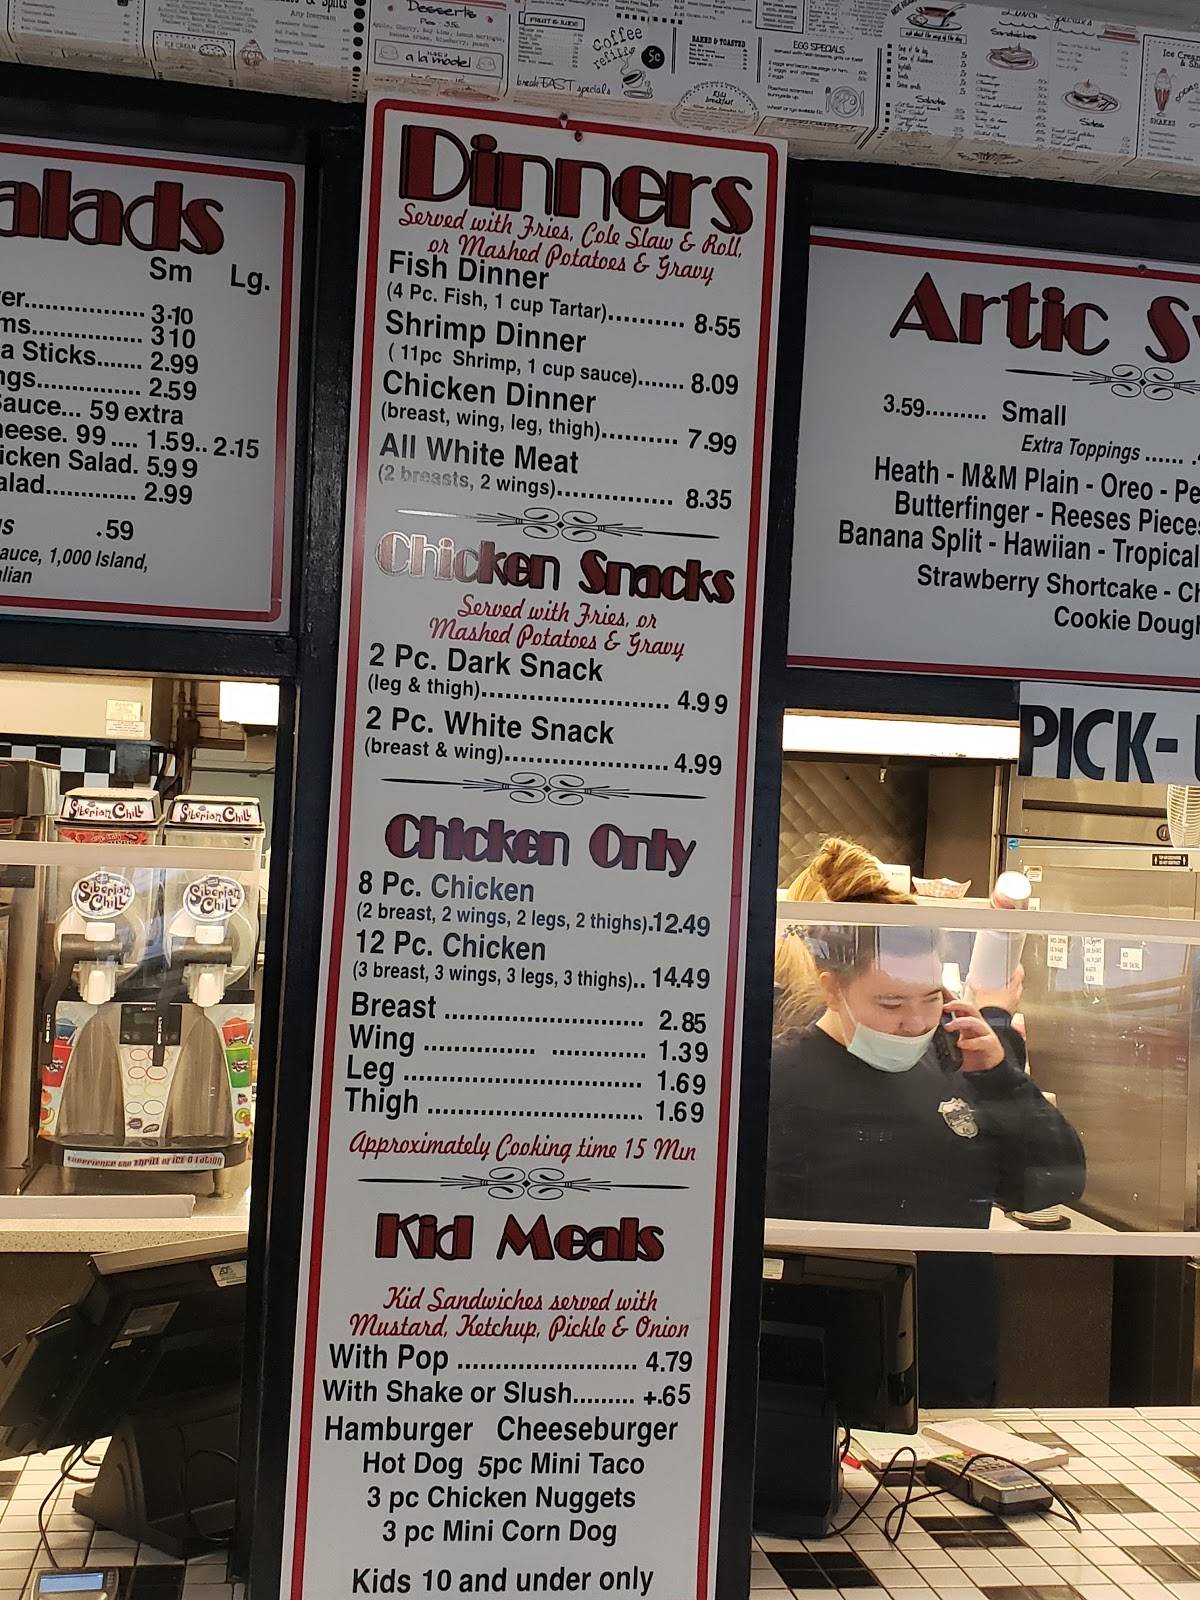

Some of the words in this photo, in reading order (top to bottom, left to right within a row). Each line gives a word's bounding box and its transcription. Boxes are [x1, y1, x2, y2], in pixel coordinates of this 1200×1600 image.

[793, 41, 809, 51] EGG
[399, 123, 754, 235] Dinners
[398, 202, 468, 230] Served
[470, 211, 512, 234] with
[517, 214, 573, 242] Fries,
[581, 222, 620, 248] Cole
[625, 226, 673, 250] Slaw
[702, 234, 741, 258] Roll,
[150, 257, 192, 283] Sm
[231, 264, 270, 295] Lg.
[389, 250, 447, 279] Fish
[459, 257, 549, 290] Dinner
[458, 234, 543, 264] Mashed
[545, 244, 626, 272] Potatoes
[656, 255, 714, 286] Gravy
[445, 287, 487, 311] Fish,
[889, 272, 1110, 356] Artic
[386, 309, 485, 349] Shrimp
[496, 320, 586, 353] Dinner
[694, 313, 740, 338] 8.55
[150, 351, 198, 374] 2.99
[401, 344, 442, 366] 11pc
[453, 349, 521, 375] Shrimp,
[691, 373, 738, 395] 8.09
[149, 377, 197, 401] 2.59
[383, 370, 495, 404] Chicken
[507, 382, 596, 413] Dinner
[124, 404, 183, 425] extra
[381, 401, 450, 426] (breast,
[457, 410, 504, 432] wing,
[511, 414, 542, 436] leg,
[689, 428, 736, 455] 7.99
[1002, 400, 1066, 426] Small
[213, 437, 259, 459] 2.15
[426, 436, 504, 467] White
[515, 445, 579, 474] Meat
[1021, 434, 1063, 454] Extra
[1070, 438, 1140, 464] Toppings
[147, 456, 197, 478] 5.99
[875, 456, 939, 484] Heath
[962, 462, 1016, 490] M&M
[1025, 467, 1078, 494] Plain
[1101, 473, 1153, 500] Oreo
[144, 482, 192, 505] 2.99
[402, 466, 473, 491] breasts,
[686, 489, 731, 510] 8.35
[895, 490, 1029, 528] Butterfinger
[1051, 502, 1130, 531] Reeses
[96, 519, 133, 540] .59
[839, 520, 923, 549] Banana
[931, 525, 982, 558] Split
[1004, 531, 1090, 560] Hawiian
[1113, 538, 1199, 571] Tropical
[50, 548, 91, 567] 1,000
[95, 550, 147, 573] Island,
[375, 530, 561, 592] Chicken
[578, 549, 735, 604] Snacks
[917, 564, 1039, 598] Strawberry
[1047, 572, 1157, 600] Shortcake
[1054, 606, 1130, 631] Cookie
[448, 648, 511, 675] Dark
[520, 653, 603, 682] Snack
[368, 673, 401, 696] (leg
[677, 690, 728, 714] 4.99
[444, 710, 522, 739] White
[531, 716, 614, 744] Snack
[365, 737, 429, 757] (breast
[674, 753, 722, 775] 4.99
[385, 813, 570, 866] Chicken
[589, 823, 697, 878] Only
[431, 874, 534, 902] Chicken
[378, 902, 435, 924] breast,
[457, 907, 510, 928] wings,
[532, 910, 570, 931] legs,
[443, 932, 545, 961] Chicken
[653, 966, 710, 989] 14.49
[352, 991, 436, 1019] Breast
[659, 1010, 706, 1034] 2.85
[349, 1024, 414, 1057] Wing
[659, 1040, 708, 1063] 1.39
[347, 1054, 394, 1087] Leg
[658, 1070, 706, 1095] 1.69
[345, 1087, 418, 1120] Thigh
[656, 1100, 704, 1123] 1.69
[349, 1130, 491, 1161] Approximately
[496, 1133, 572, 1164] Cooking
[576, 1136, 617, 1158] time
[626, 1138, 647, 1159] 15
[654, 1138, 696, 1161] Min
[375, 1213, 474, 1261] Kid
[496, 1214, 664, 1262] Meals
[383, 1287, 425, 1309] Kid
[427, 1287, 542, 1312] Sandwiches
[548, 1289, 614, 1311] served
[615, 1289, 657, 1311] with
[350, 1313, 447, 1337] Mustard,
[456, 1314, 540, 1344] Ketchup,
[548, 1315, 606, 1342] Pickle
[636, 1315, 689, 1338] Onion
[329, 1343, 387, 1369] With
[398, 1344, 448, 1376] Pop
[646, 1351, 692, 1372] 4.79
[323, 1379, 377, 1402] With
[387, 1380, 463, 1403] Shake
[325, 1416, 473, 1448] Hamburger
[497, 1416, 678, 1447] Cheeseburger
[363, 1451, 406, 1474] Hot
[414, 1452, 463, 1480] Dog
[478, 1456, 522, 1480] 5pc
[531, 1452, 580, 1474] Mini
[589, 1452, 644, 1474] Taco
[428, 1486, 526, 1508] Chicken
[536, 1486, 635, 1513] Nuggets
[443, 1519, 493, 1541] Mini
[502, 1519, 560, 1542] Corn
[569, 1520, 616, 1547] Dog
[353, 1568, 411, 1593] Kids
[423, 1569, 451, 1591] 10
[459, 1567, 507, 1593] and
[517, 1566, 591, 1592] under
[600, 1565, 654, 1596] only
